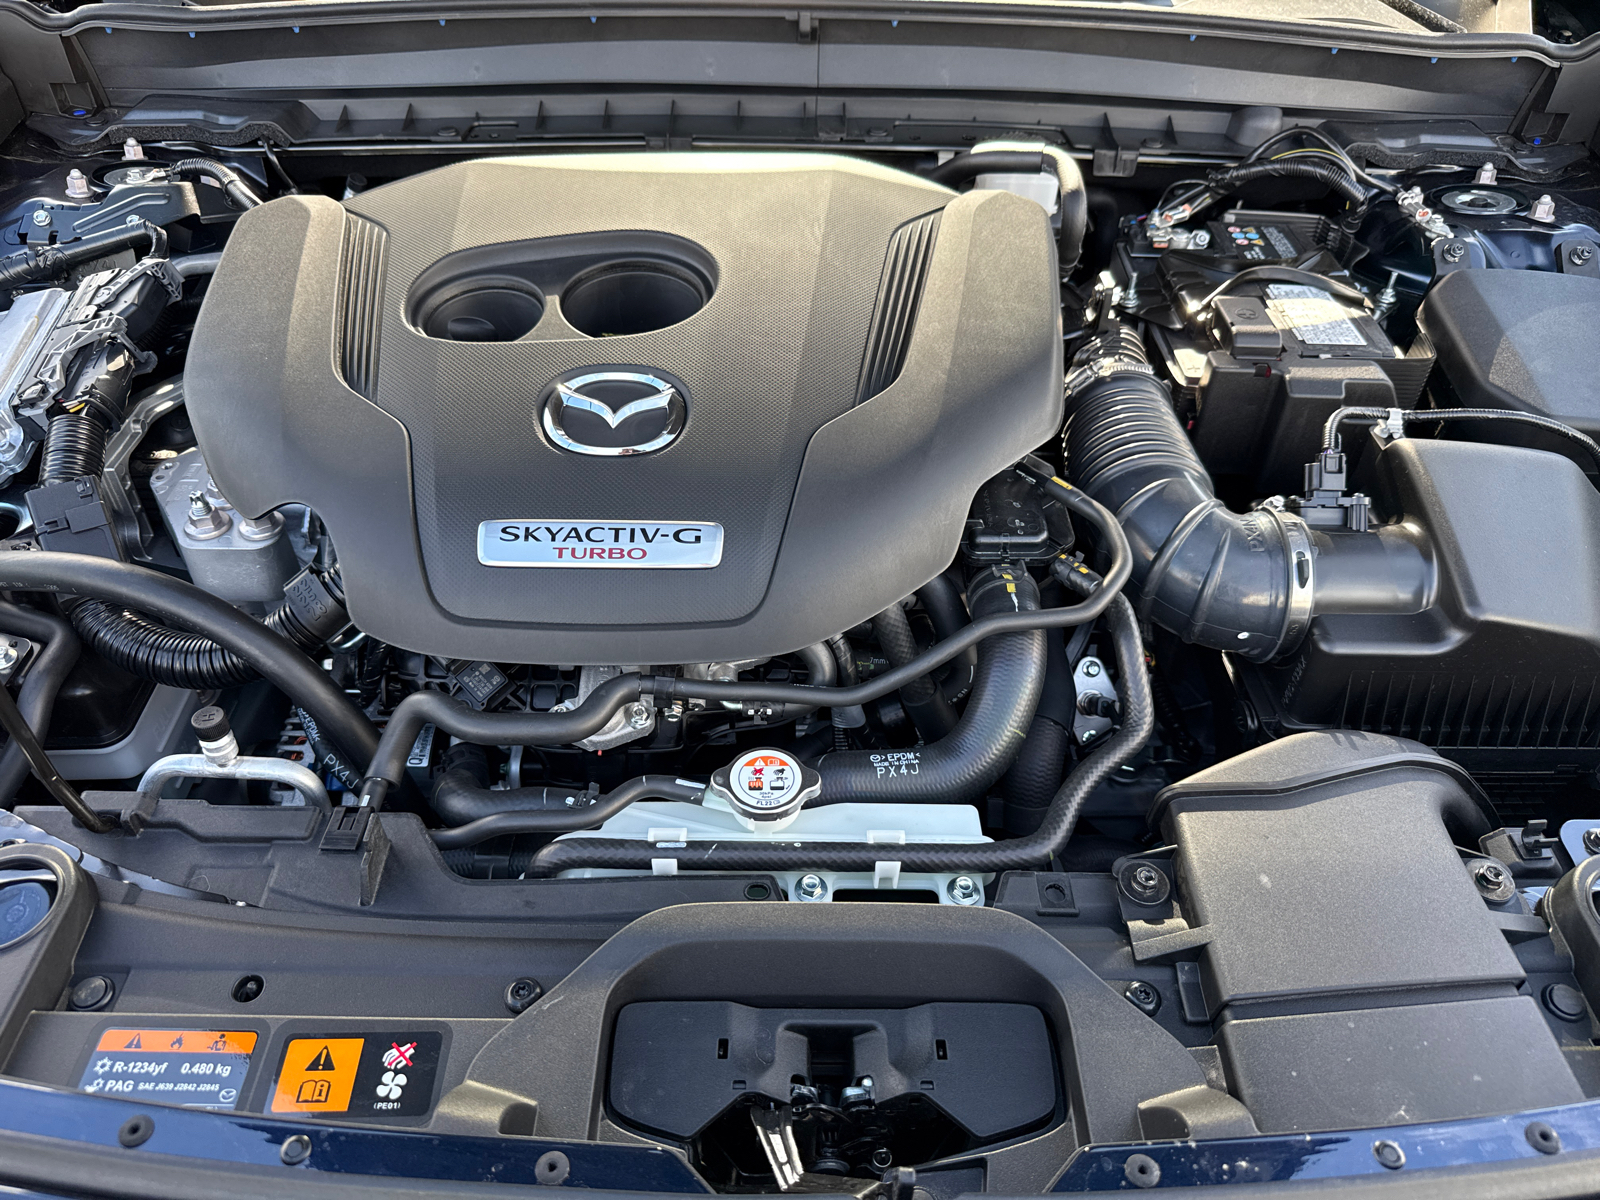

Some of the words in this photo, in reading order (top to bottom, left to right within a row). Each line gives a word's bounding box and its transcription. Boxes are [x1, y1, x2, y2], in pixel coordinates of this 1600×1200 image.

[499, 525, 702, 544] SKYACTIV-G
[552, 547, 648, 560] TURBO
[323, 753, 360, 789] PX4J
[876, 763, 919, 779] PX4J
[112, 1061, 169, 1076] R-1234yf
[180, 1063, 214, 1075] 0.480
[215, 1063, 232, 1077] kg
[104, 1079, 135, 1092] PAG
[137, 1082, 155, 1091] SAE
[155, 1082, 174, 1091] J639
[373, 1102, 401, 1110] (PE01)
